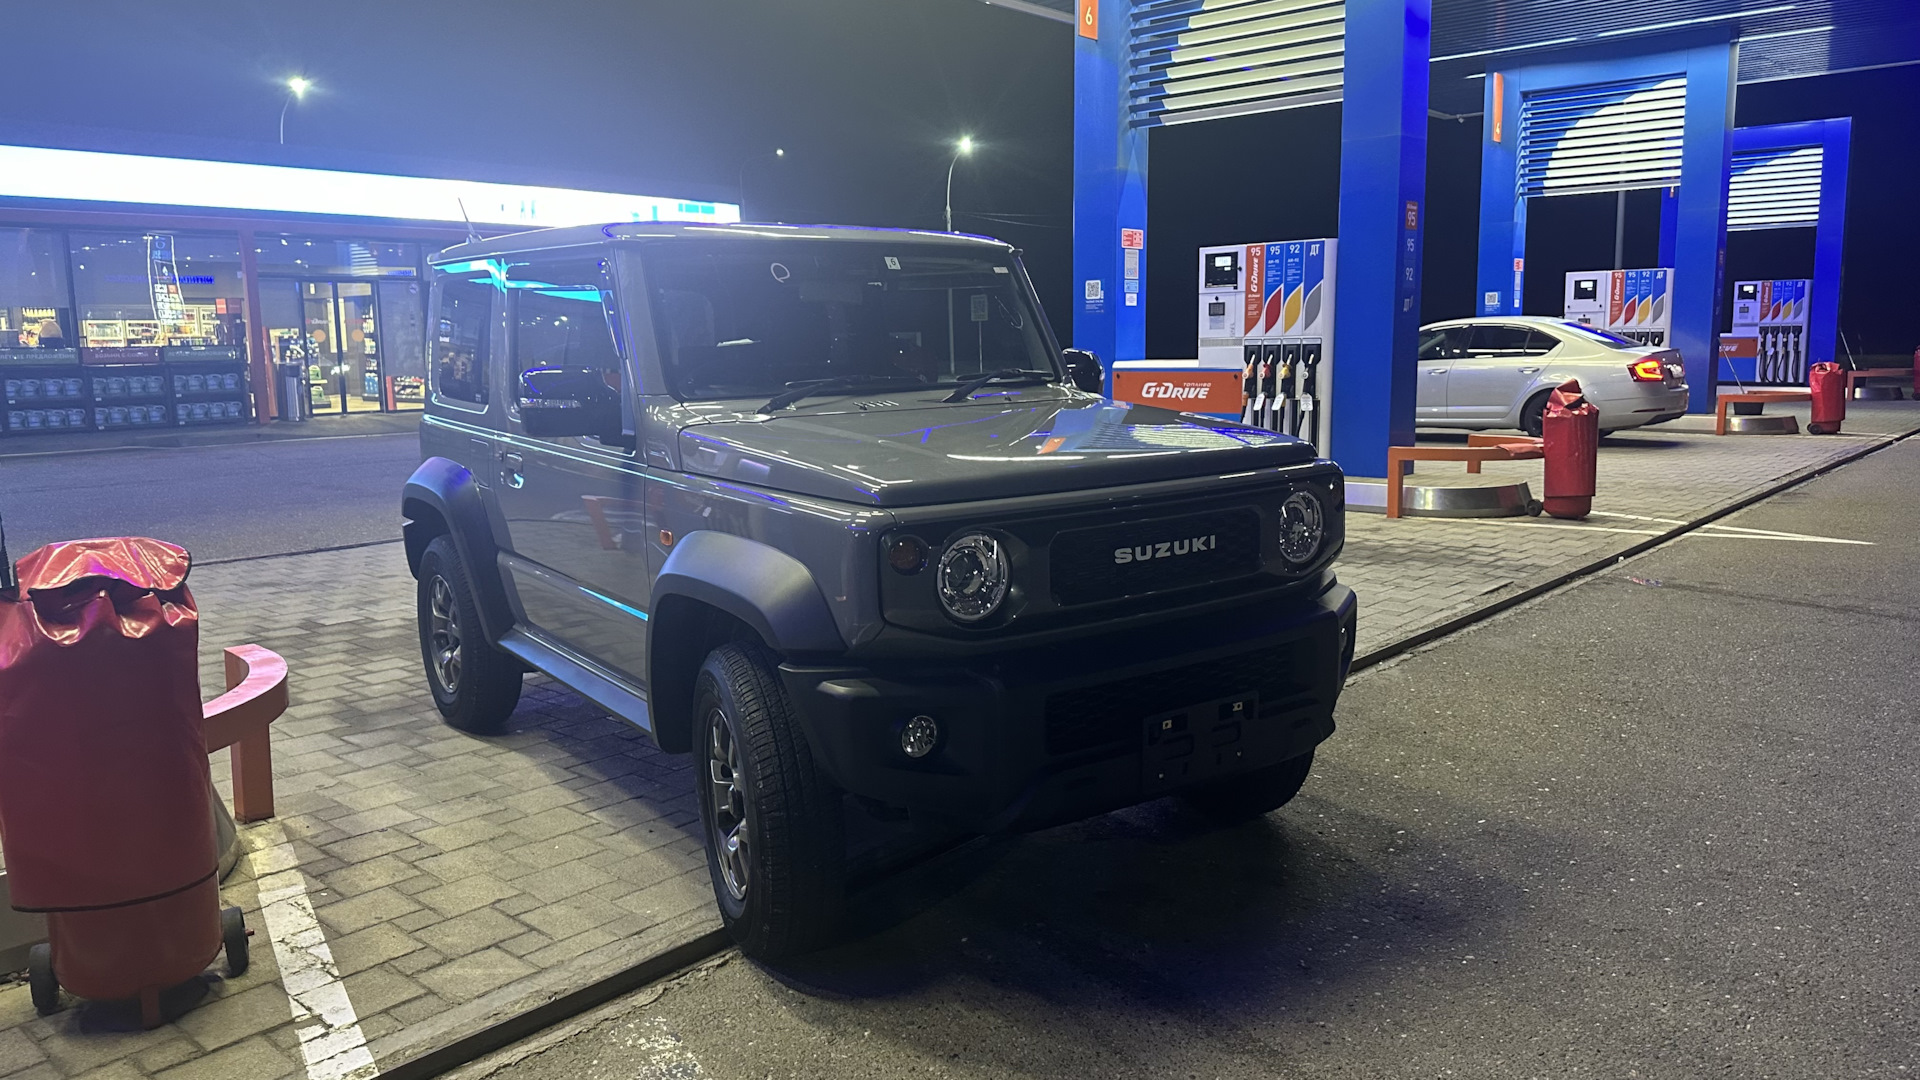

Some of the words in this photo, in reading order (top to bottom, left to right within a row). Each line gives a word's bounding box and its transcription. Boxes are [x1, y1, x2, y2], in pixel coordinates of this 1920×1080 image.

[1085, 6, 1093, 26] 6
[1407, 211, 1416, 226] 95
[1250, 247, 1261, 256] 95
[1270, 245, 1281, 255] 95
[1289, 244, 1300, 254] 92
[1309, 243, 1320, 256] ДТ
[1406, 238, 1415, 252] 95
[1405, 267, 1414, 281] 92
[1114, 535, 1216, 564] SUZUKI
